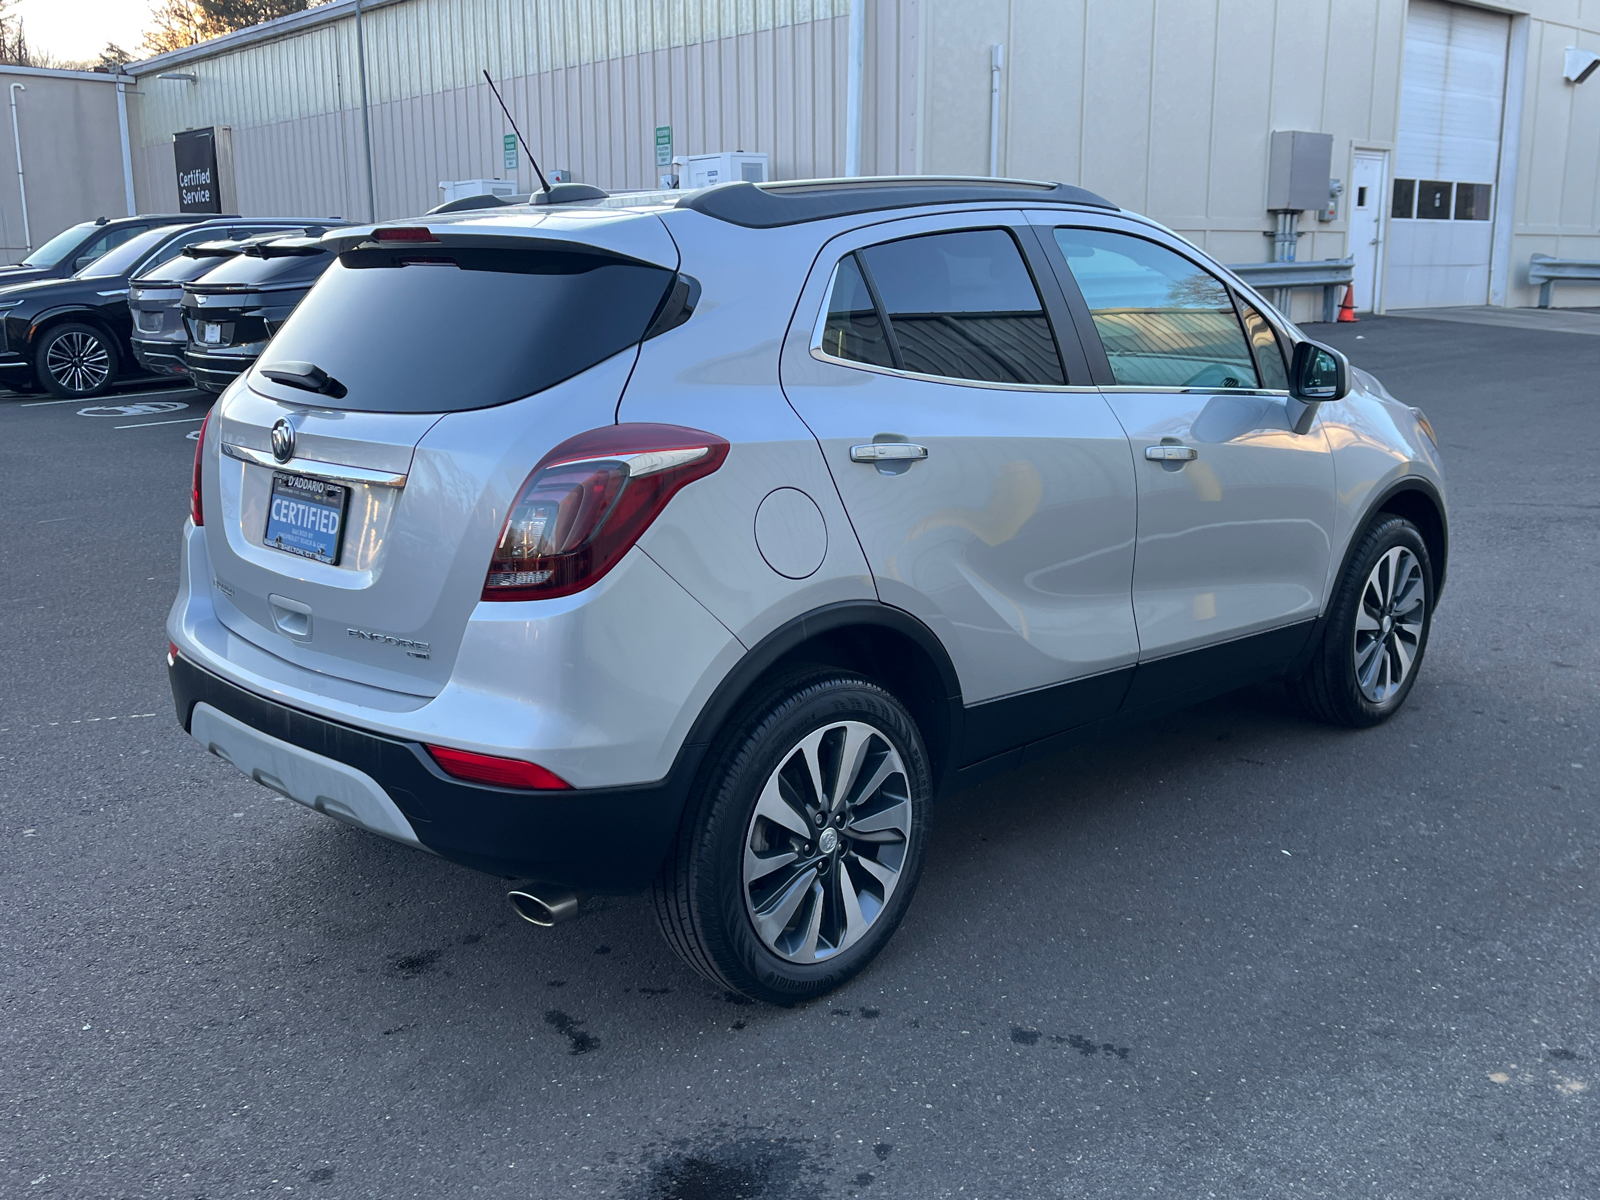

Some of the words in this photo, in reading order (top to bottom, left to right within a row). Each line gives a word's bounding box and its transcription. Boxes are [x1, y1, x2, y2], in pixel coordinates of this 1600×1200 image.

[180, 168, 210, 187] Certified
[183, 187, 210, 204] Service
[288, 476, 324, 493] D'ADDARIO
[272, 499, 339, 535] CERTIFIED
[346, 628, 432, 652] ENCORE
